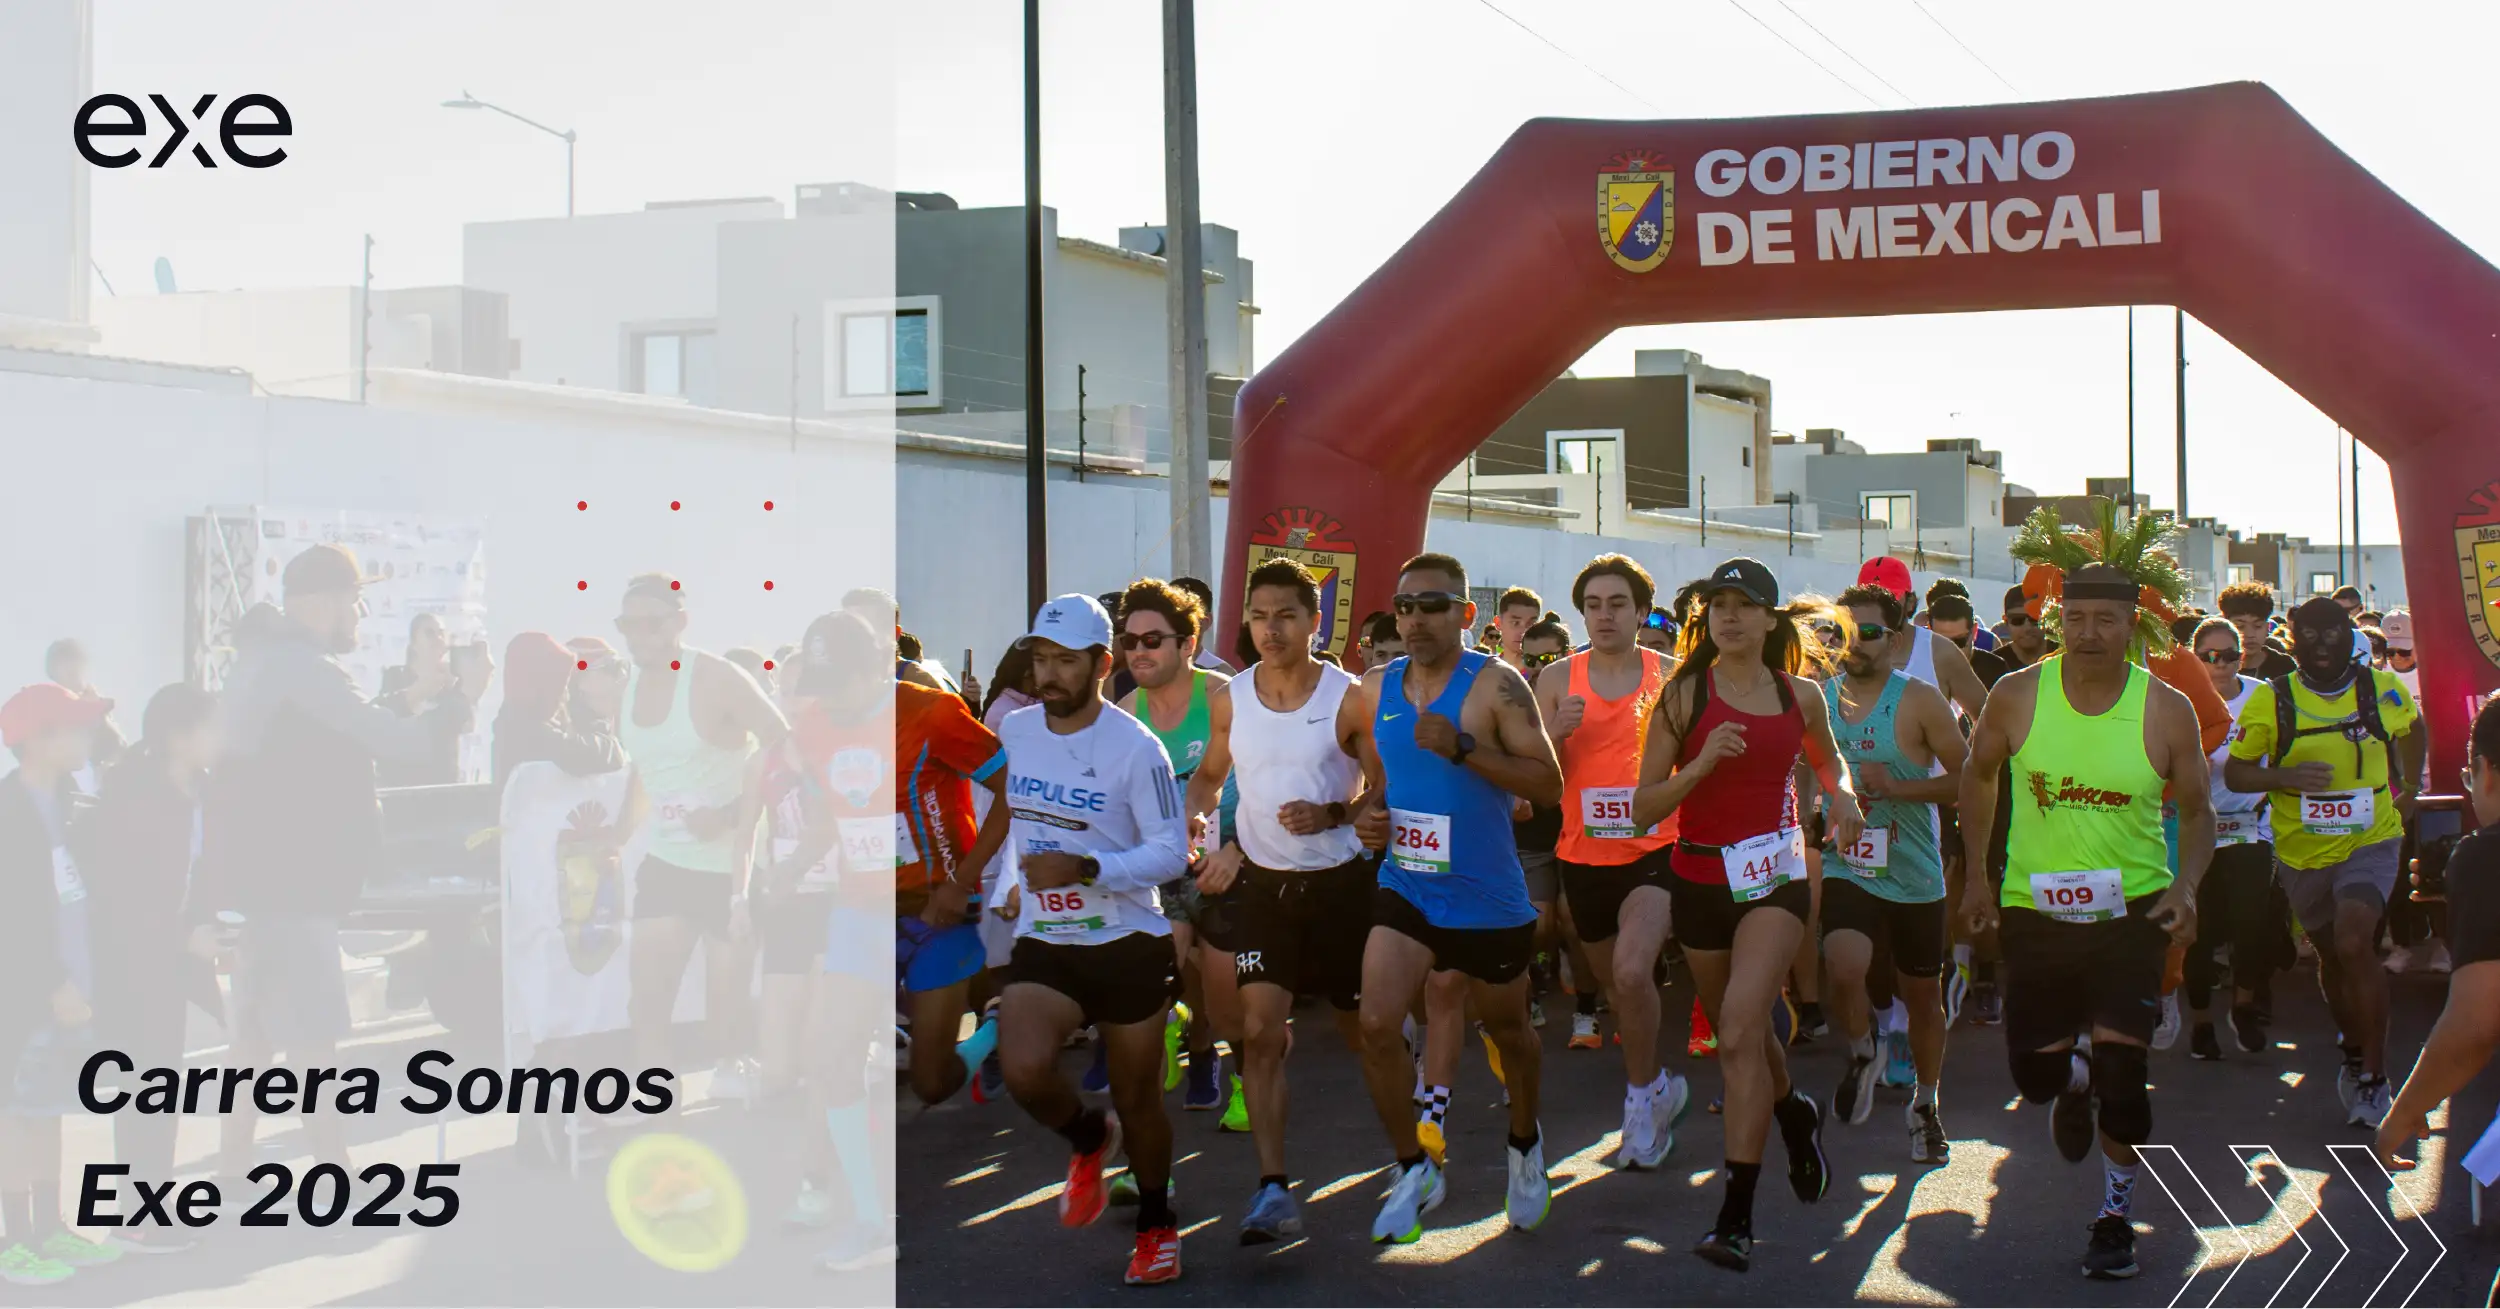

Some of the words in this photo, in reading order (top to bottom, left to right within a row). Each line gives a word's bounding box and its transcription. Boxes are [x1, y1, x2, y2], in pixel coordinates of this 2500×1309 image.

[1694, 130, 2076, 197] GOBIERNO
[1697, 209, 1795, 266] DE
[1815, 189, 2162, 261] MEXICALI
[2477, 528, 2500, 541] Mex
[1312, 553, 1335, 566] Cali
[1335, 578, 1353, 656] LIDA
[1592, 801, 1631, 819] 351
[2069, 804, 2089, 812] MIRO
[2308, 803, 2353, 819] 290
[2216, 821, 2240, 833] 98
[1395, 825, 1440, 852] 284
[1844, 842, 1874, 860] 12
[1743, 852, 1780, 881] 441
[1035, 891, 1085, 912] 186
[2043, 886, 2094, 906] 109
